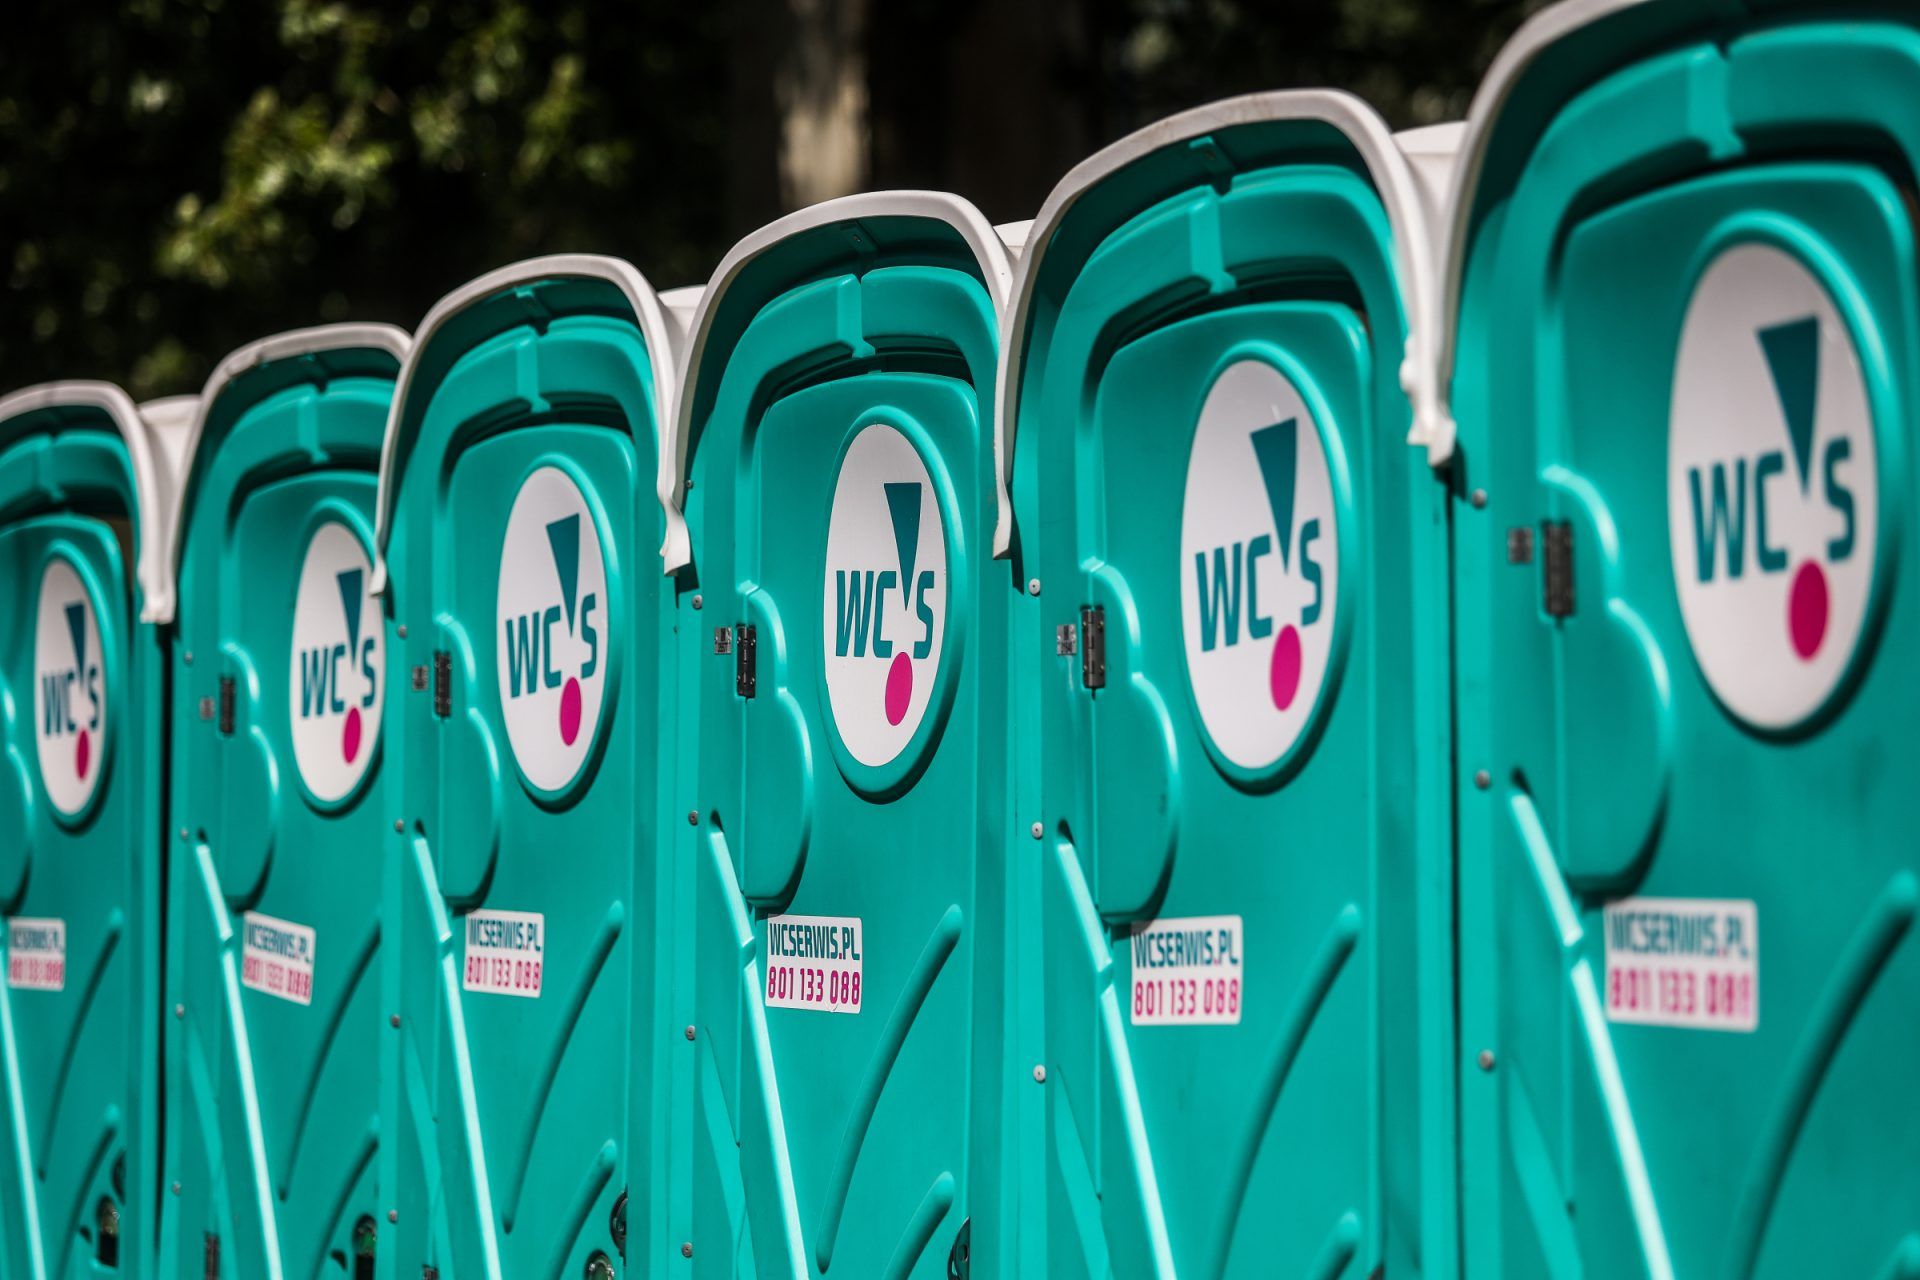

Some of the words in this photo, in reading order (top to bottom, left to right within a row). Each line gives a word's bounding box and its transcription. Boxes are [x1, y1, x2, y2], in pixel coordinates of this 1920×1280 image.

[467, 918, 541, 951] WCSERWIS.PL
[769, 923, 861, 961] WCSERWIS.PL
[1133, 929, 1239, 968] WCSERWIS.PL
[1610, 911, 1749, 960] WCSERWIS.PL
[467, 956, 488, 986] 801
[491, 958, 511, 987] 133
[514, 960, 540, 990] 088
[768, 966, 794, 999] 801
[800, 968, 825, 1002] 133
[830, 970, 861, 1005] 088
[1611, 966, 1650, 1010] 801
[1657, 968, 1696, 1014] 133
[1135, 981, 1163, 1016] 801
[1170, 980, 1197, 1015] 133
[1204, 978, 1238, 1015] 088
